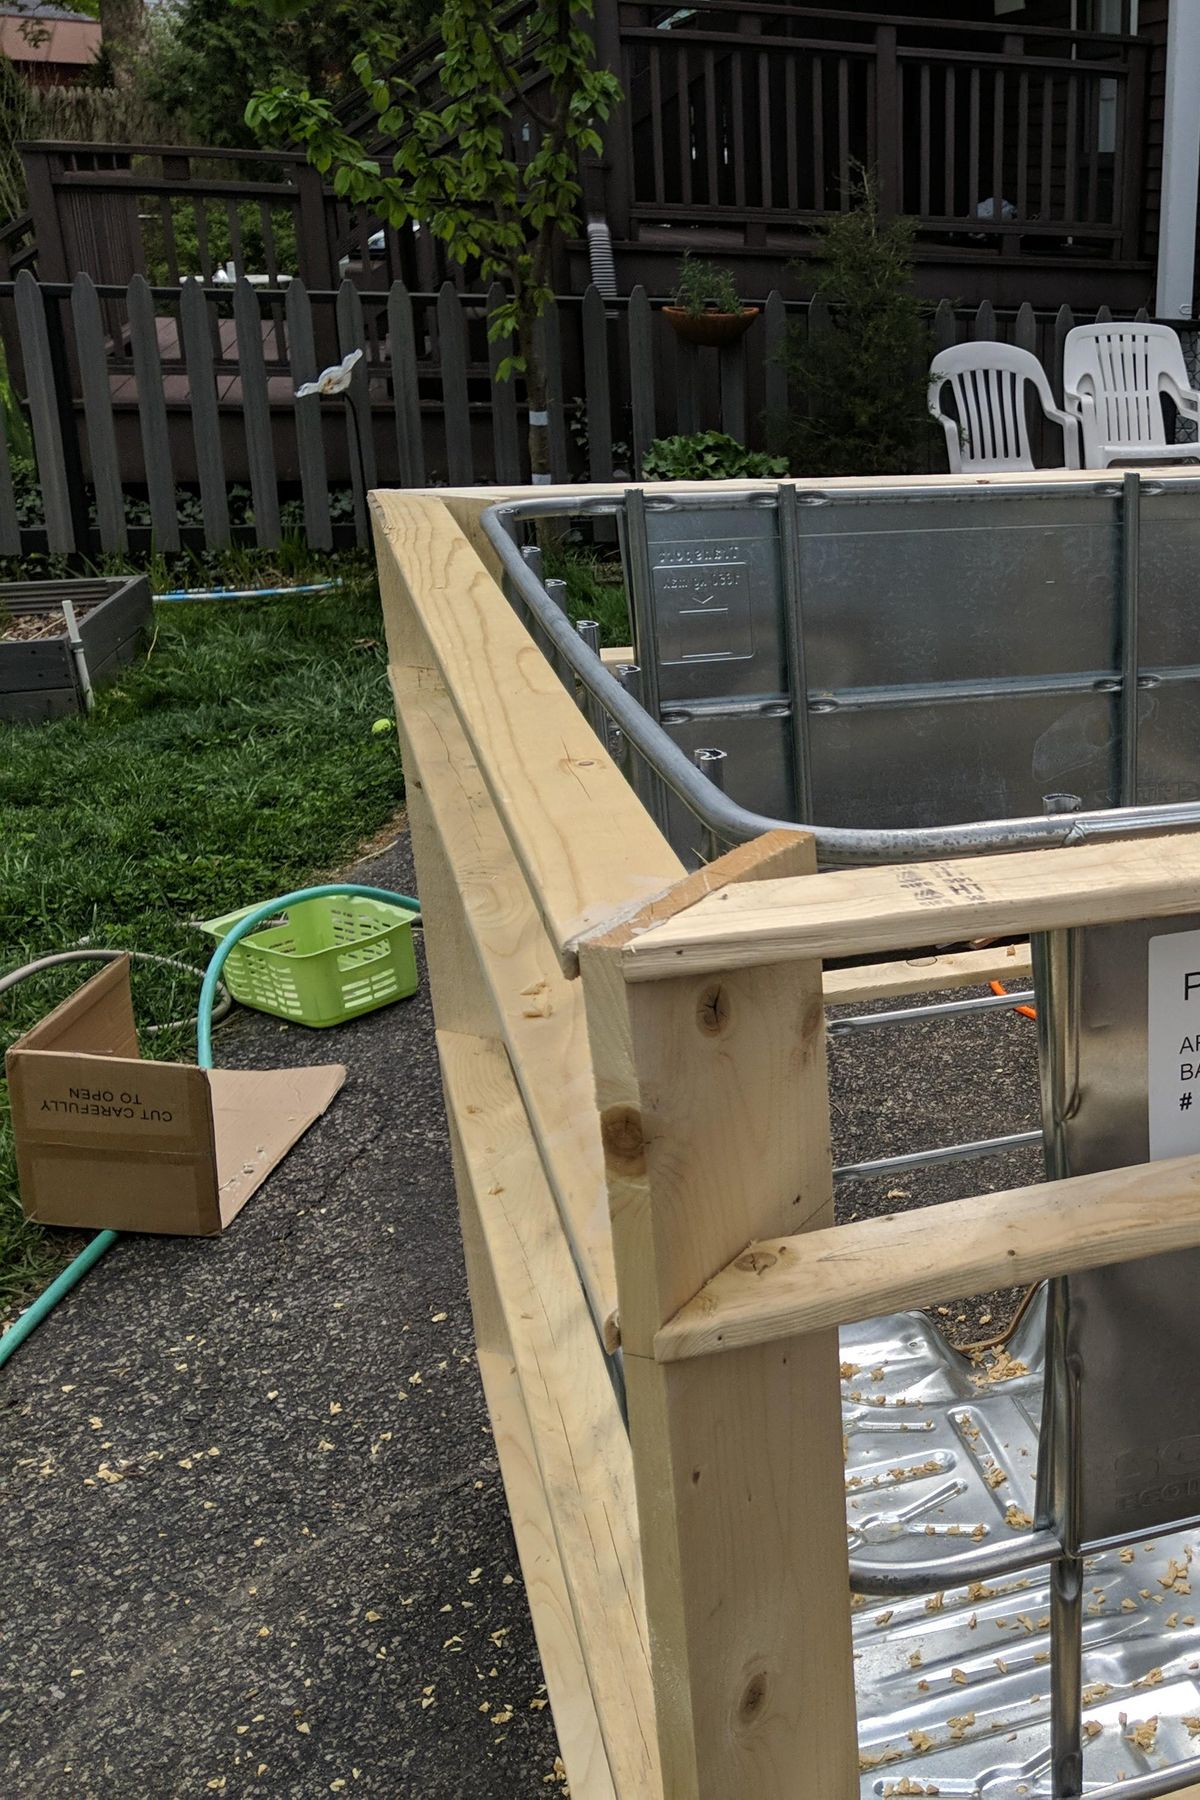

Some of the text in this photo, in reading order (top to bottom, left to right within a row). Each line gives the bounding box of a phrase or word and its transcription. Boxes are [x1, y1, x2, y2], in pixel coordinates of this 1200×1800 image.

[69, 1087, 142, 1104] TO OPEN
[41, 1100, 172, 1122] CUT CAREFULLY
